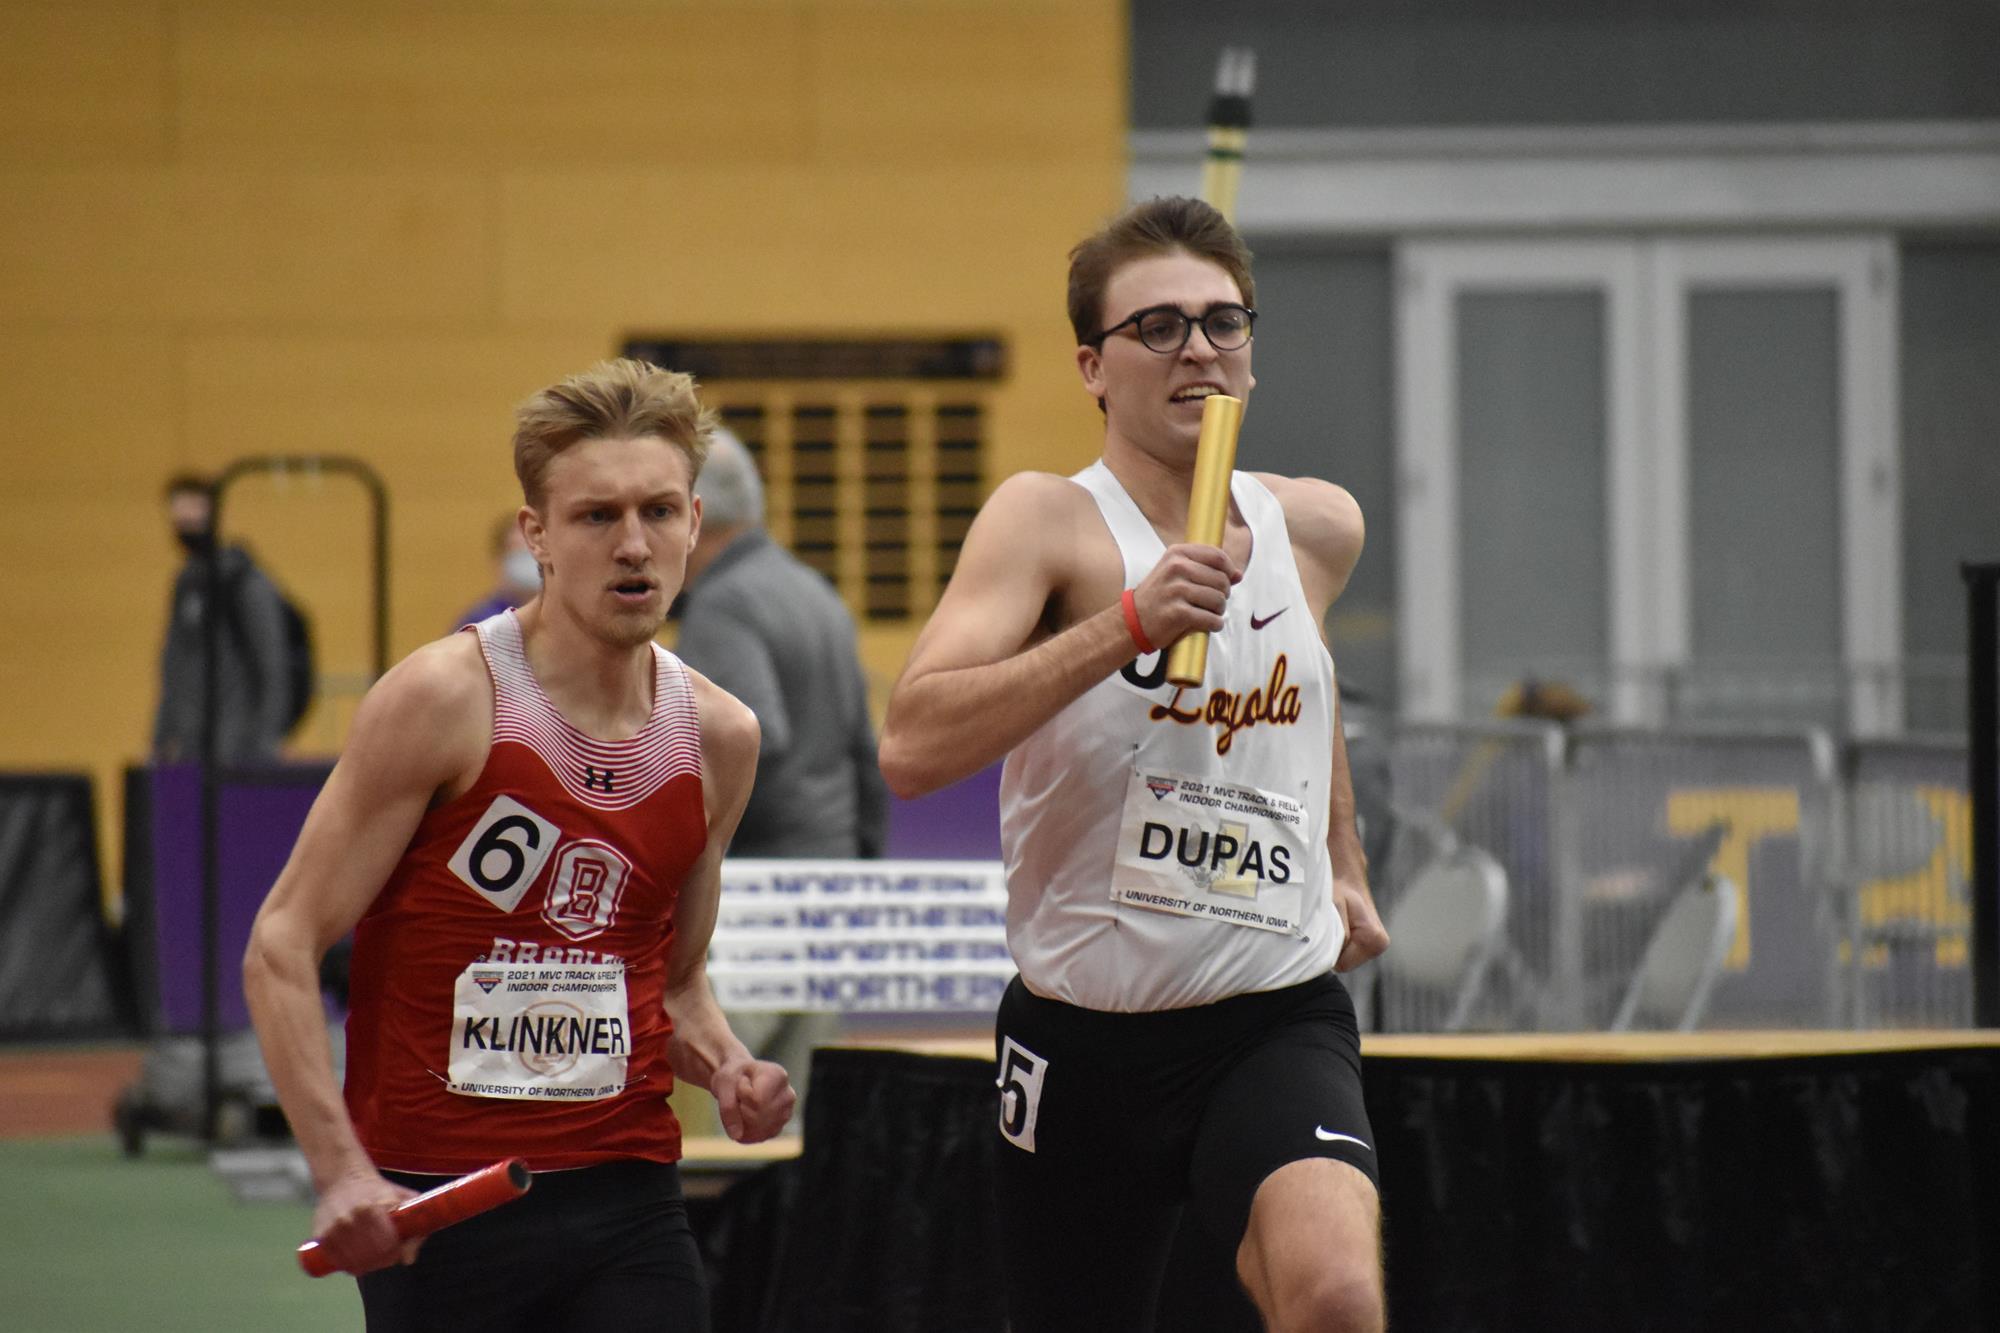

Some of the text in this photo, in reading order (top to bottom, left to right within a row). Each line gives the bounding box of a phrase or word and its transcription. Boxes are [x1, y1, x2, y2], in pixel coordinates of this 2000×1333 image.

[1149, 653, 1302, 756] Loyola
[1178, 793, 1301, 825] INDOOR CHAMPIONSHIPS
[1180, 780, 1211, 794] 2021
[1213, 786, 1237, 799] MVC
[1238, 791, 1268, 806] TRACK
[469, 815, 540, 892] 6
[1139, 821, 1291, 885] DUPAS
[1126, 889, 1289, 929] UNIVERSITY OF NORTHERN IOWA
[506, 982, 549, 993] INDOOR
[551, 983, 617, 994] CHAMPIONSHIPS
[507, 970, 536, 981] 2021
[539, 970, 562, 981] MVC
[564, 971, 596, 981] TRACK
[463, 1016, 625, 1055] KLINKNER
[460, 1082, 524, 1096] UNIVERSITY
[528, 1087, 543, 1096] OF
[544, 1086, 595, 1098] NORTHERN
[1002, 1047, 1035, 1137] 5
